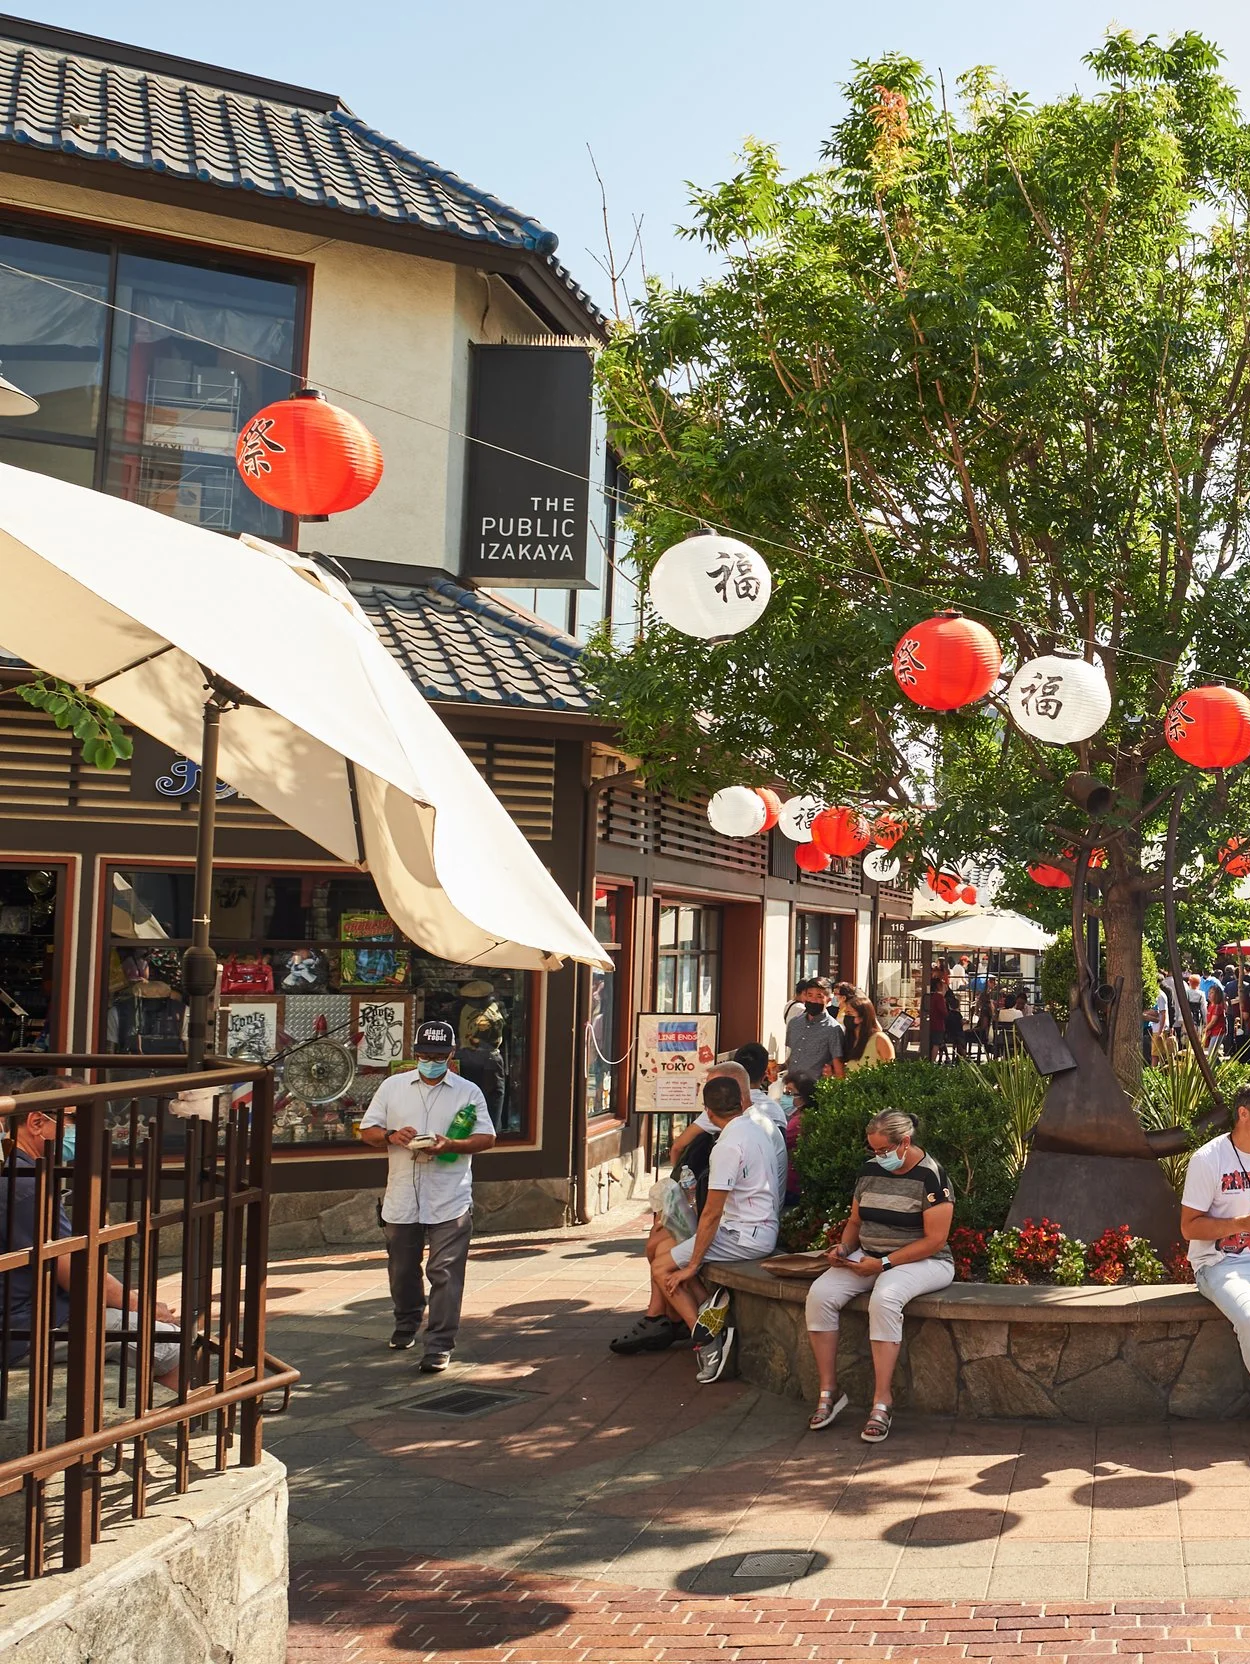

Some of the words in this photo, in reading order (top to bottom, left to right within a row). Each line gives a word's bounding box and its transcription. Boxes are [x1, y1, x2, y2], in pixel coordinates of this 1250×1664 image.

[238, 418, 286, 479] 祭
[530, 497, 575, 512] THE
[481, 517, 575, 538] PUBLIC
[480, 543, 574, 561] IZAKAYA
[705, 551, 761, 604] 福
[1019, 671, 1064, 721] 福
[890, 923, 905, 932] 116
[423, 1027, 446, 1037] giant
[427, 1034, 447, 1042] robot
[659, 1033, 676, 1041] LINE
[677, 1033, 698, 1041] ENDS
[661, 1062, 696, 1072] TOKYO
